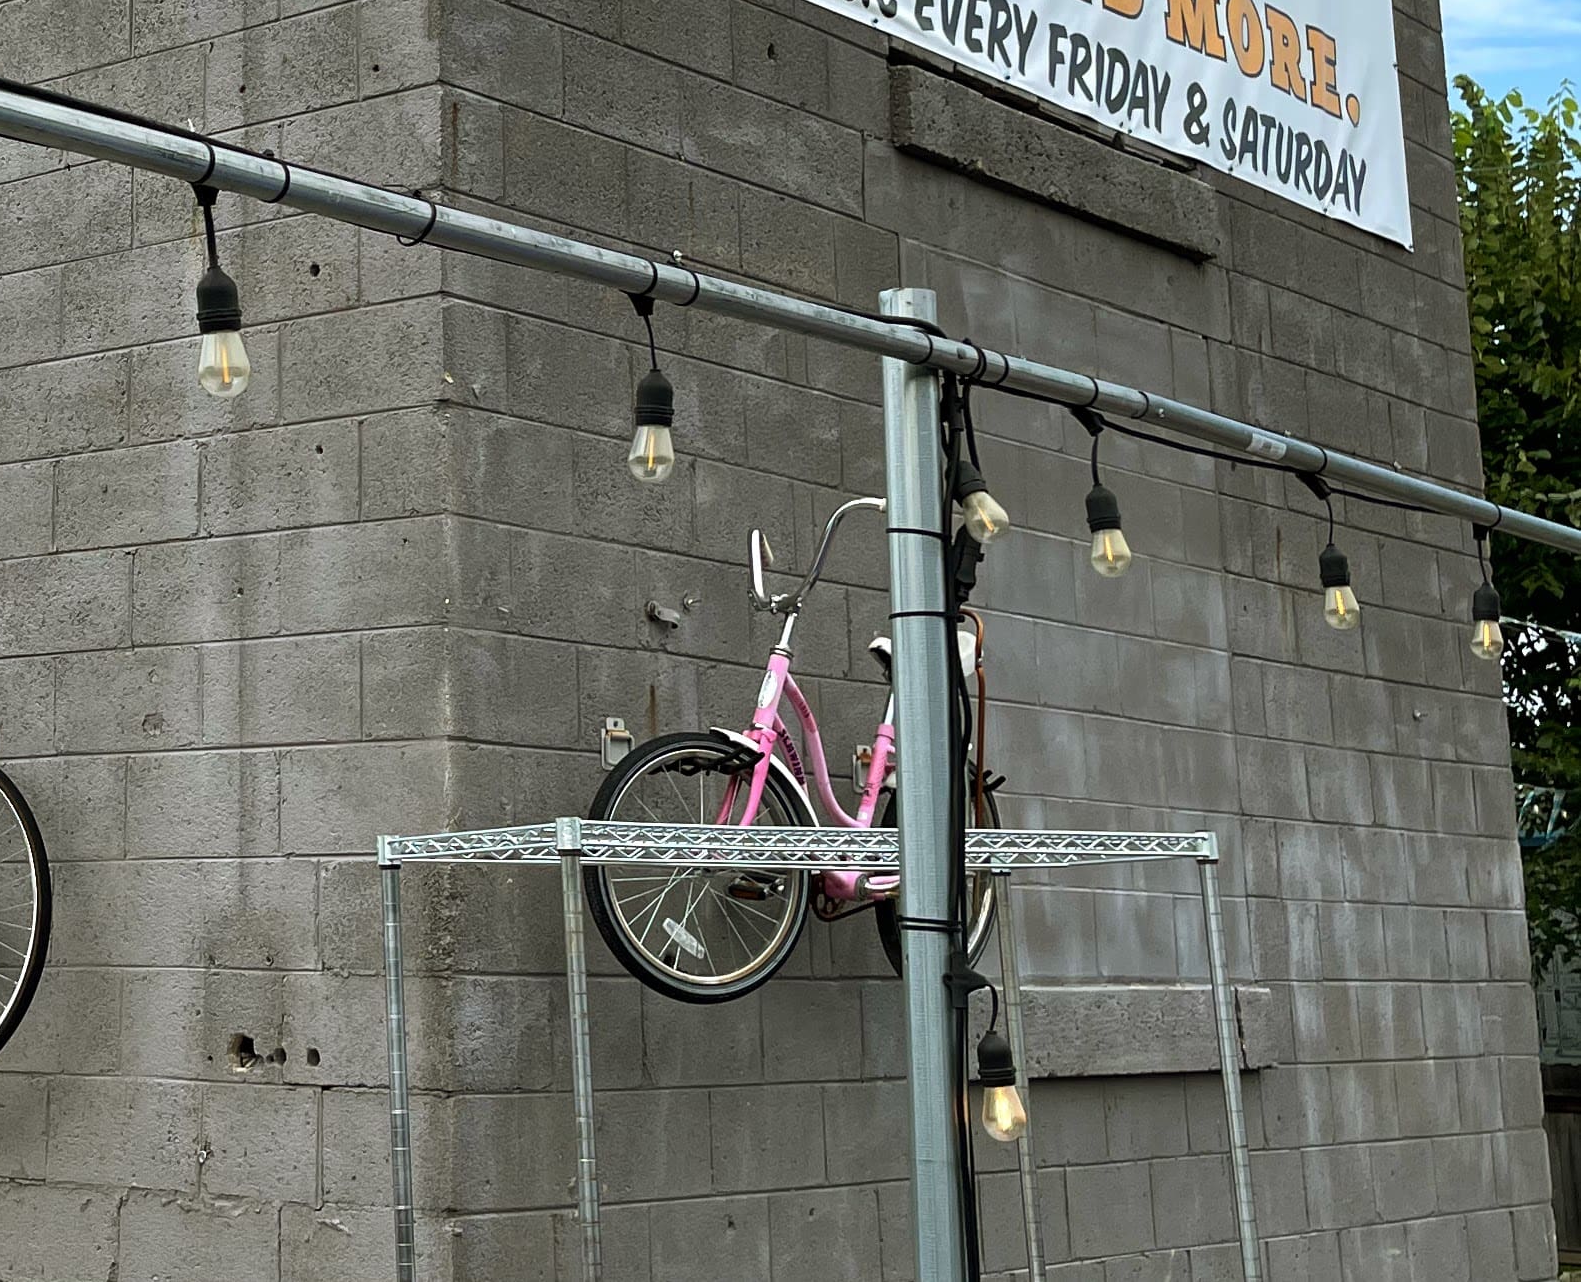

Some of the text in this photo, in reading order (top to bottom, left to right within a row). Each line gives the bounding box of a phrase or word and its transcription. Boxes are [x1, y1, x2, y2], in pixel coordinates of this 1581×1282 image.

[1048, 23, 1171, 133] FRIDAY
[1183, 82, 1210, 147] &
[1220, 98, 1366, 216] SATURDAY
